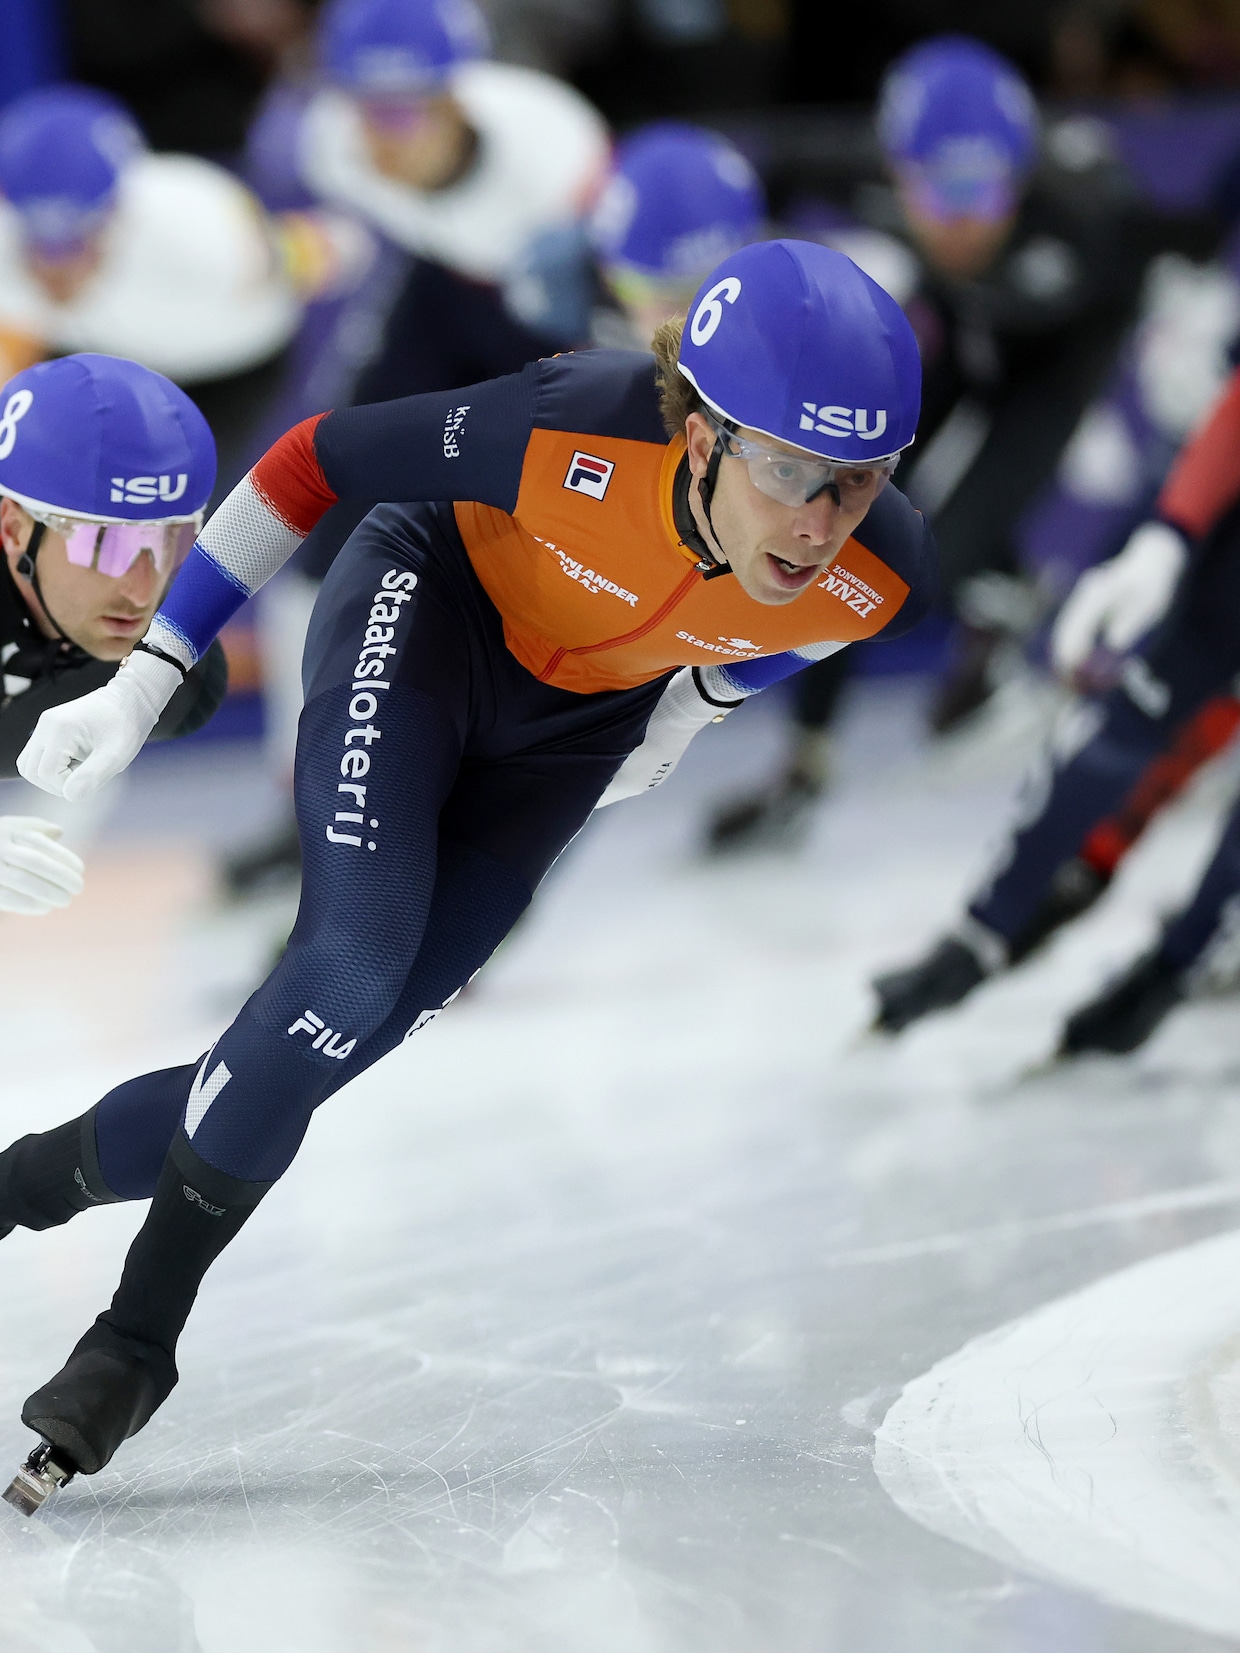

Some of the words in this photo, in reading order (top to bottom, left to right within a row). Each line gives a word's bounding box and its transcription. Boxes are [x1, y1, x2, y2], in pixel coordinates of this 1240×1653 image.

[691, 277, 742, 346] 6
[799, 402, 887, 440] ISU
[110, 474, 188, 504] ISU
[534, 536, 639, 607] AANLANDER
[832, 564, 884, 604] ZONWERING
[325, 568, 418, 851] Staatsloterij
[288, 1010, 358, 1060] FILA
